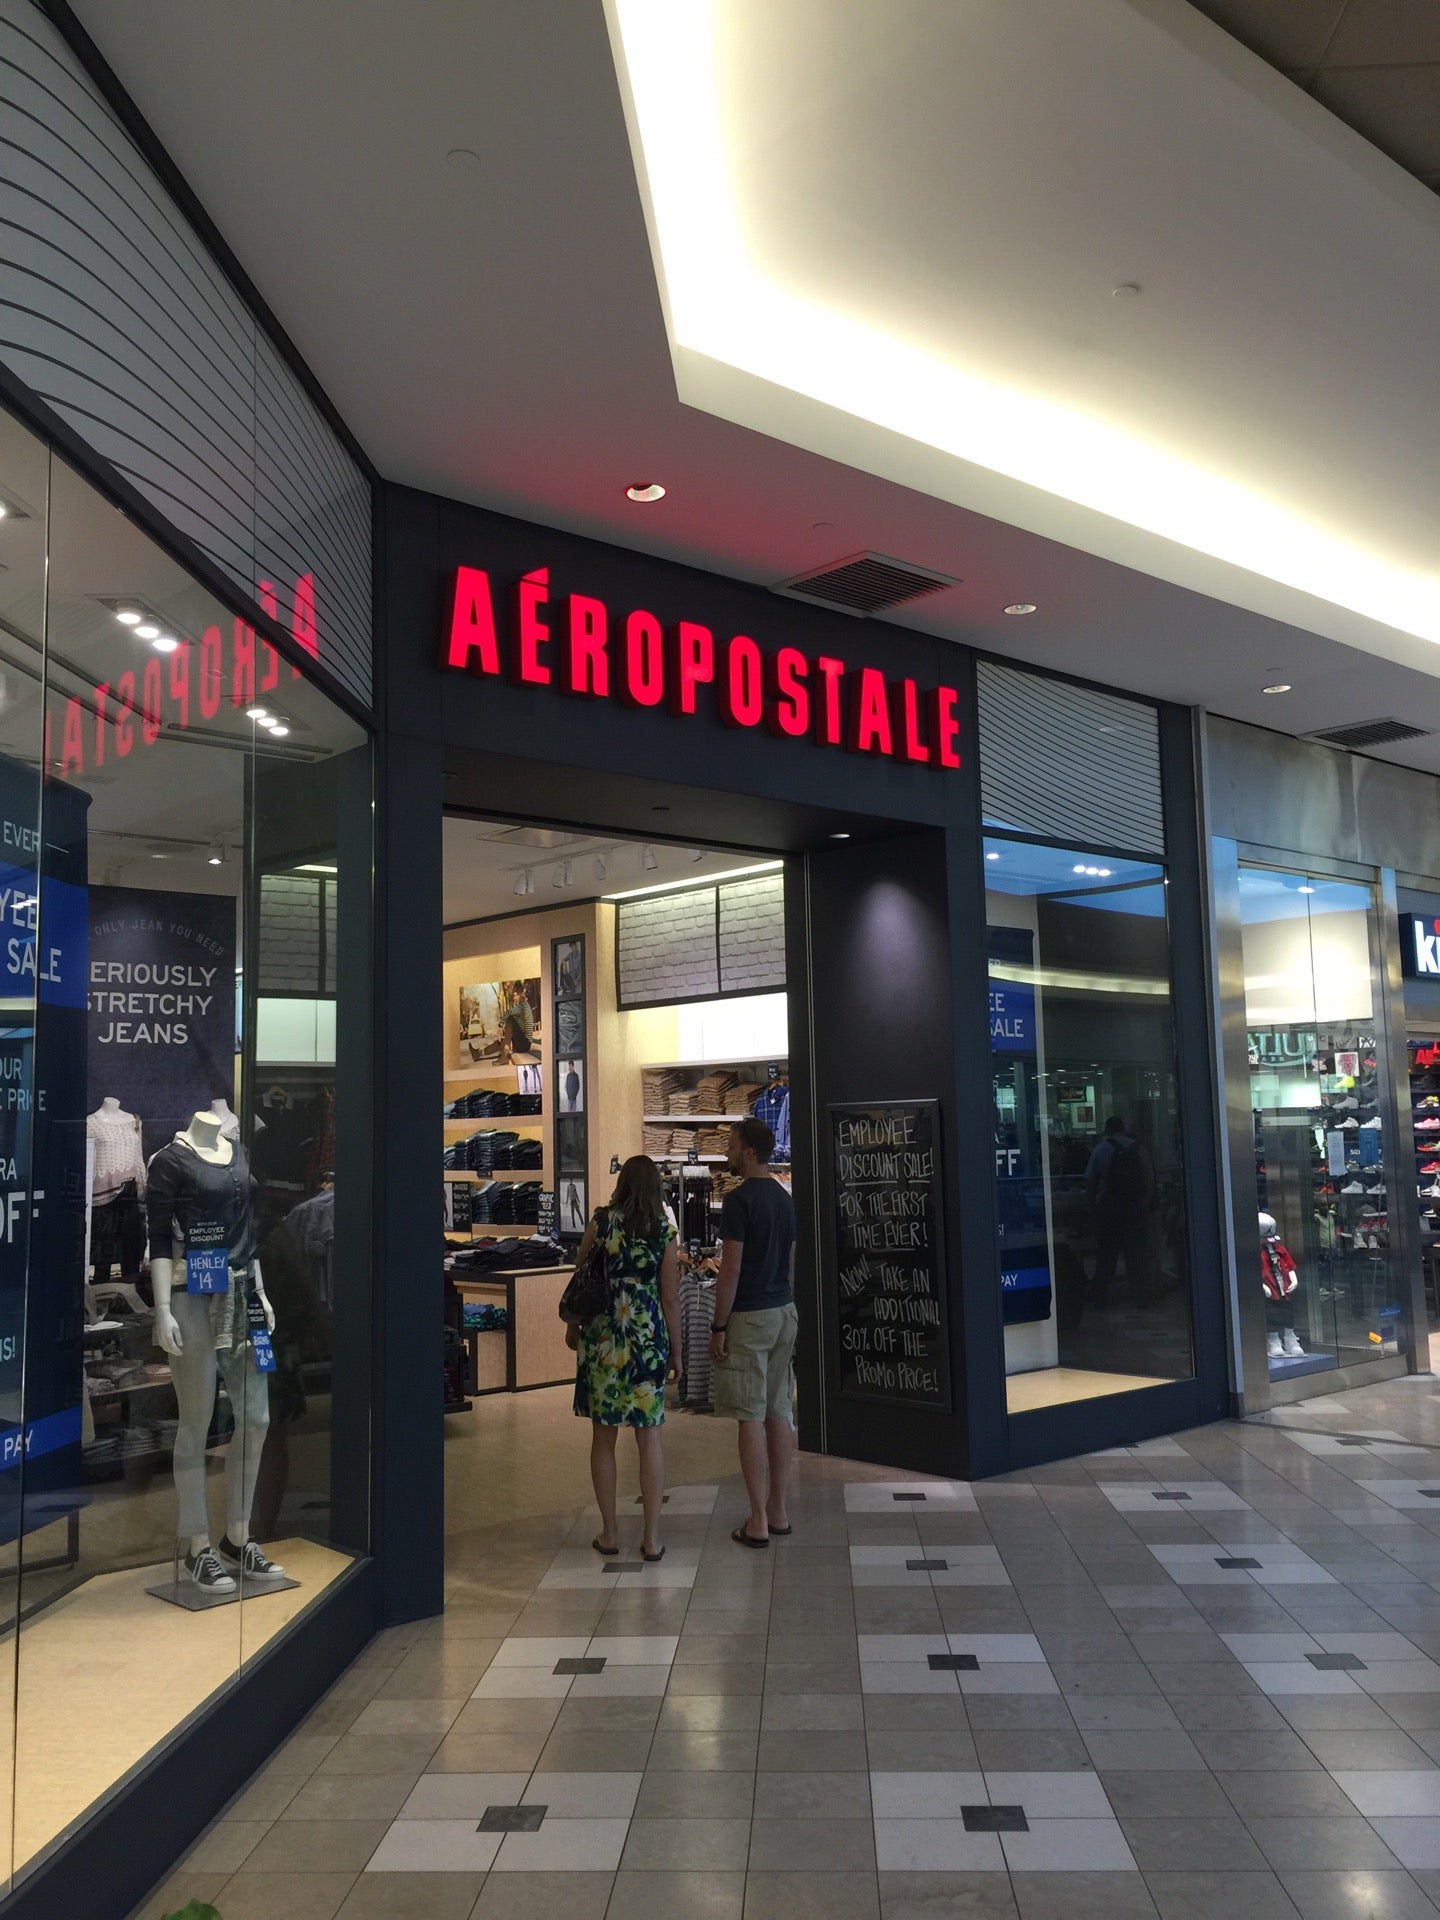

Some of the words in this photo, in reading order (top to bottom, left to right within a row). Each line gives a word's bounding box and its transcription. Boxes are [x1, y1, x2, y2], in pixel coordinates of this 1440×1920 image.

[447, 563, 962, 770] AÉROPOSTALE
[94, 920, 126, 936] ONLY
[132, 919, 164, 931] JEAN
[169, 922, 193, 938] YOU
[195, 933, 225, 957] NEED
[97, 1021, 190, 1045] JEANS
[8, 1087, 47, 1111] PRIE
[838, 1115, 918, 1147] EMPLOYEE
[839, 1151, 902, 1181] DISCOUNT
[903, 1147, 935, 1178] SALE!
[839, 1191, 865, 1217] FOR
[865, 1190, 890, 1217] THE
[891, 1190, 928, 1217] FIRST
[189, 1226, 225, 1235] EMPLOYEE
[190, 1234, 224, 1243] DISCOUNT
[847, 1221, 882, 1249] TIME
[884, 1220, 929, 1249] EVER!
[190, 1256, 226, 1270] HENLEY
[839, 1254, 872, 1296] NOW!
[875, 1262, 910, 1292] TAKE
[912, 1267, 931, 1293] AN
[873, 1295, 940, 1326] ADDITIONAL
[842, 1323, 871, 1351] 30%
[873, 1326, 897, 1353] OFF
[900, 1329, 929, 1358] THE
[855, 1354, 896, 1390] PROMO
[897, 1361, 939, 1392] PRICE!
